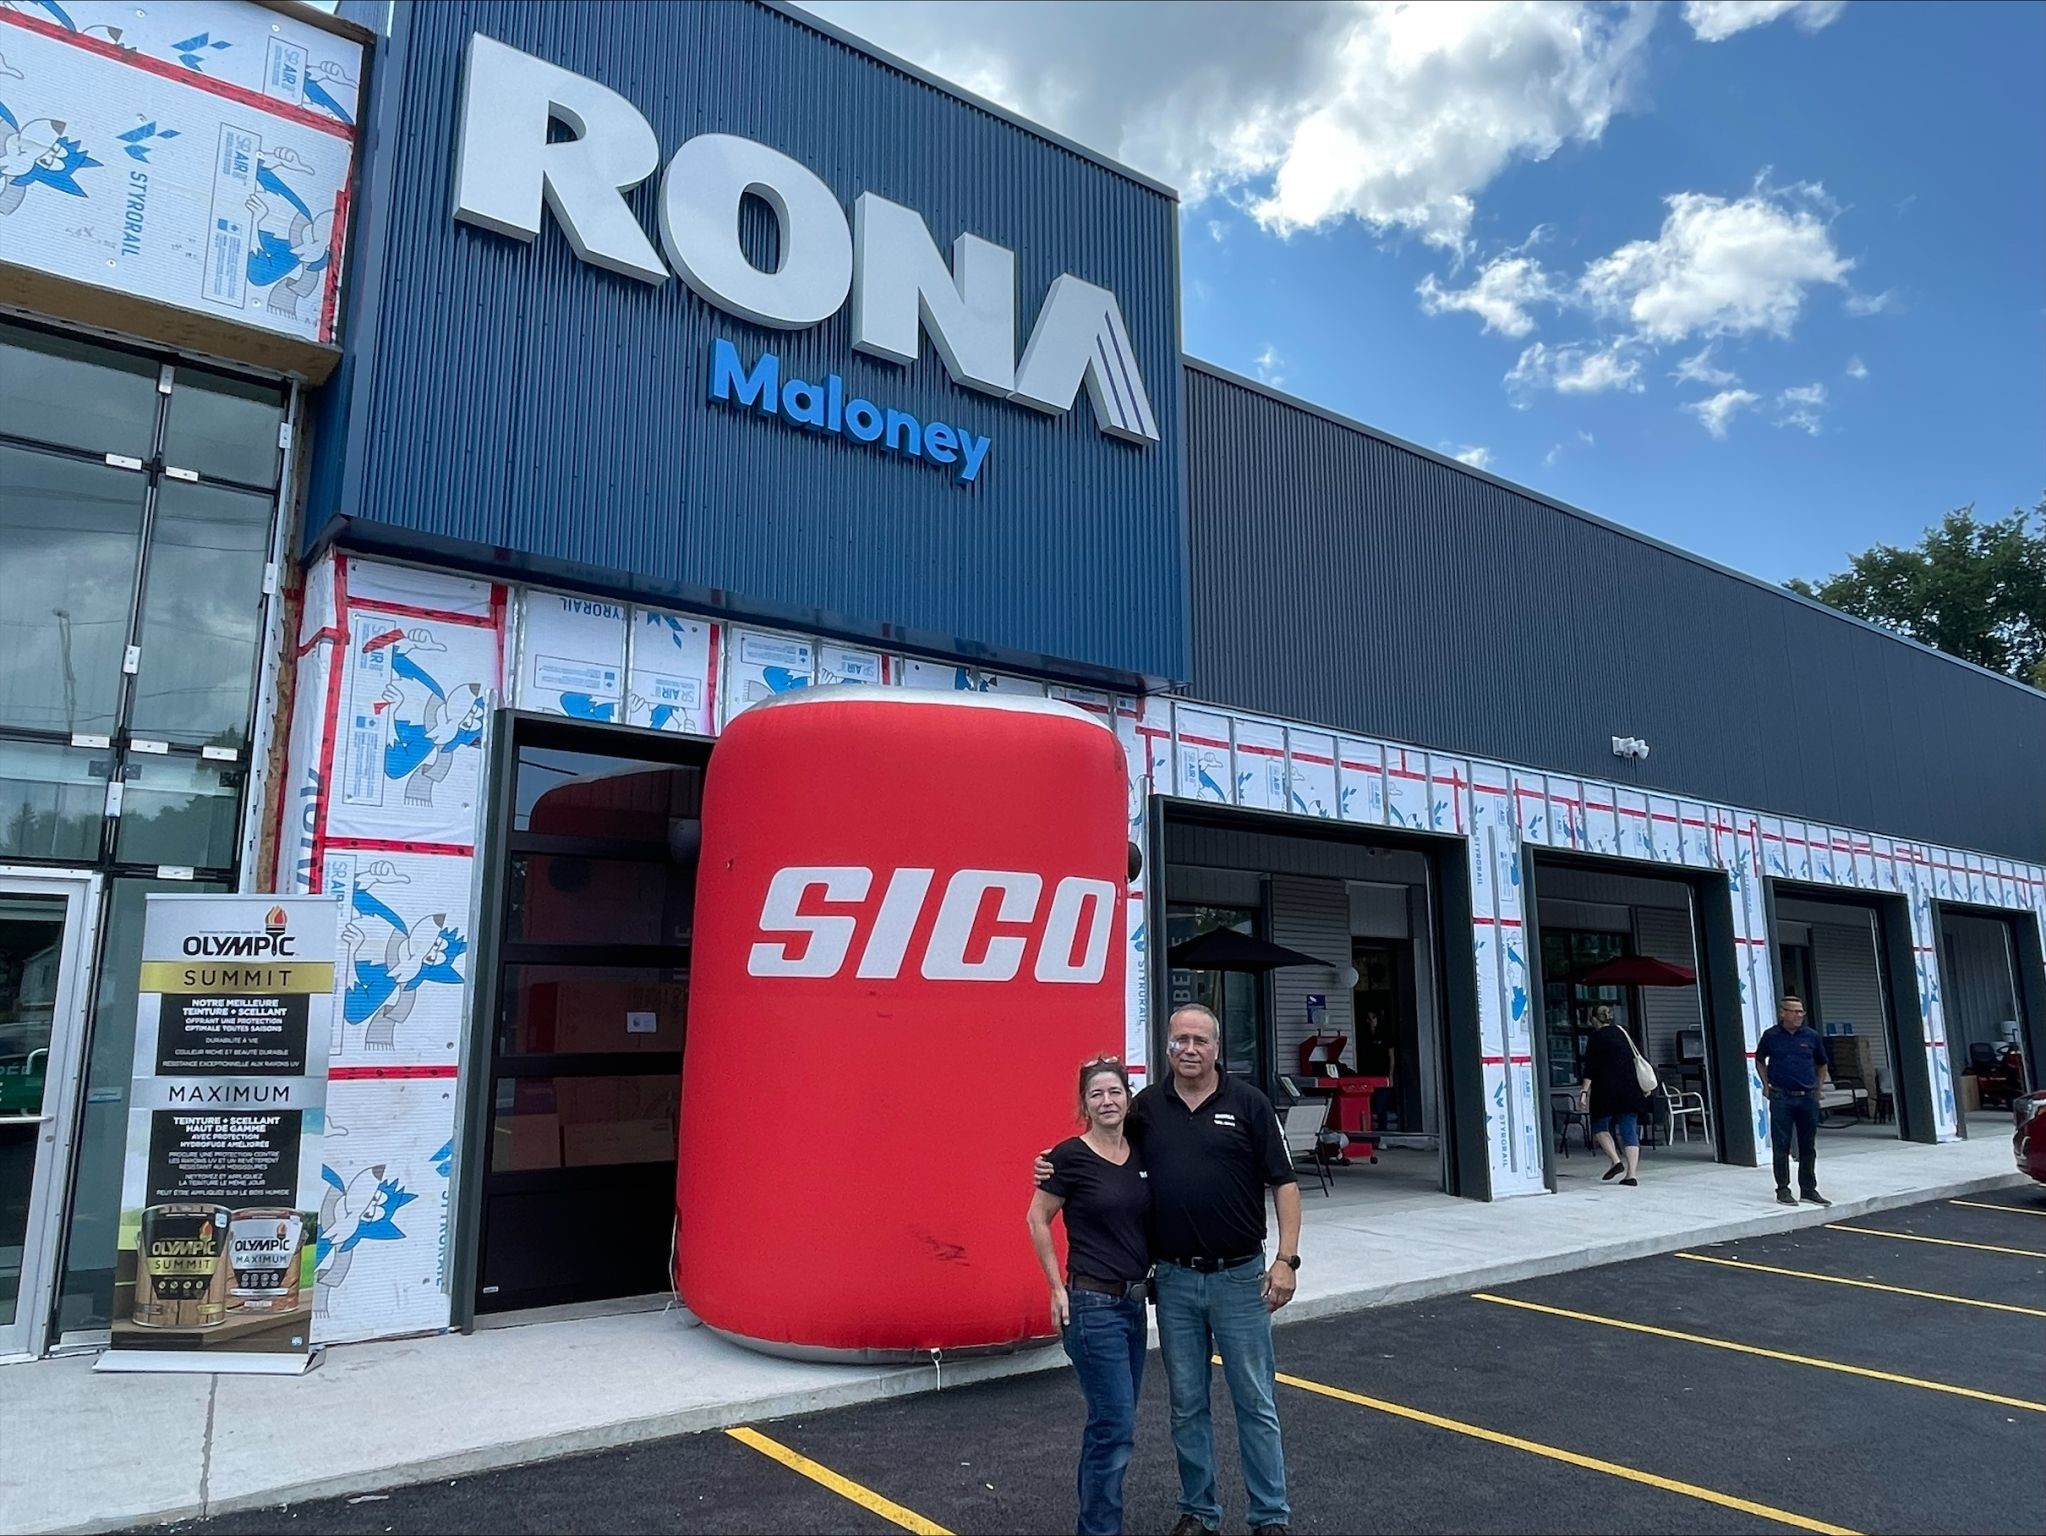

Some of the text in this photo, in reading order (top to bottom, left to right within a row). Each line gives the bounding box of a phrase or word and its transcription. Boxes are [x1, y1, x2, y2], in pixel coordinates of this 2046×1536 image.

[121, 171, 148, 257] STYRORAIL
[453, 31, 1160, 447] RONA
[708, 338, 992, 485] Maloney
[558, 597, 623, 620] YRORAIL
[661, 687, 680, 700] AIR
[746, 866, 1117, 985] SICO
[182, 934, 297, 957] OLYMPIC
[183, 969, 292, 987] SUMMIT
[191, 999, 279, 1007] NOTRE MEILLEURE
[182, 1008, 229, 1016] TEINTURE
[238, 1008, 288, 1016] SCELLANT
[168, 1085, 290, 1102] MAXIMUM
[173, 1117, 221, 1125] TEINTURE
[230, 1117, 280, 1125] SCELLANT
[1498, 1113, 1509, 1168] STYRORAIL
[152, 1240, 218, 1256] OLYMPIC
[235, 1239, 290, 1251] OLYMPIC
[154, 1259, 211, 1270] SUMMIT
[235, 1254, 288, 1264] MAXIMUM
